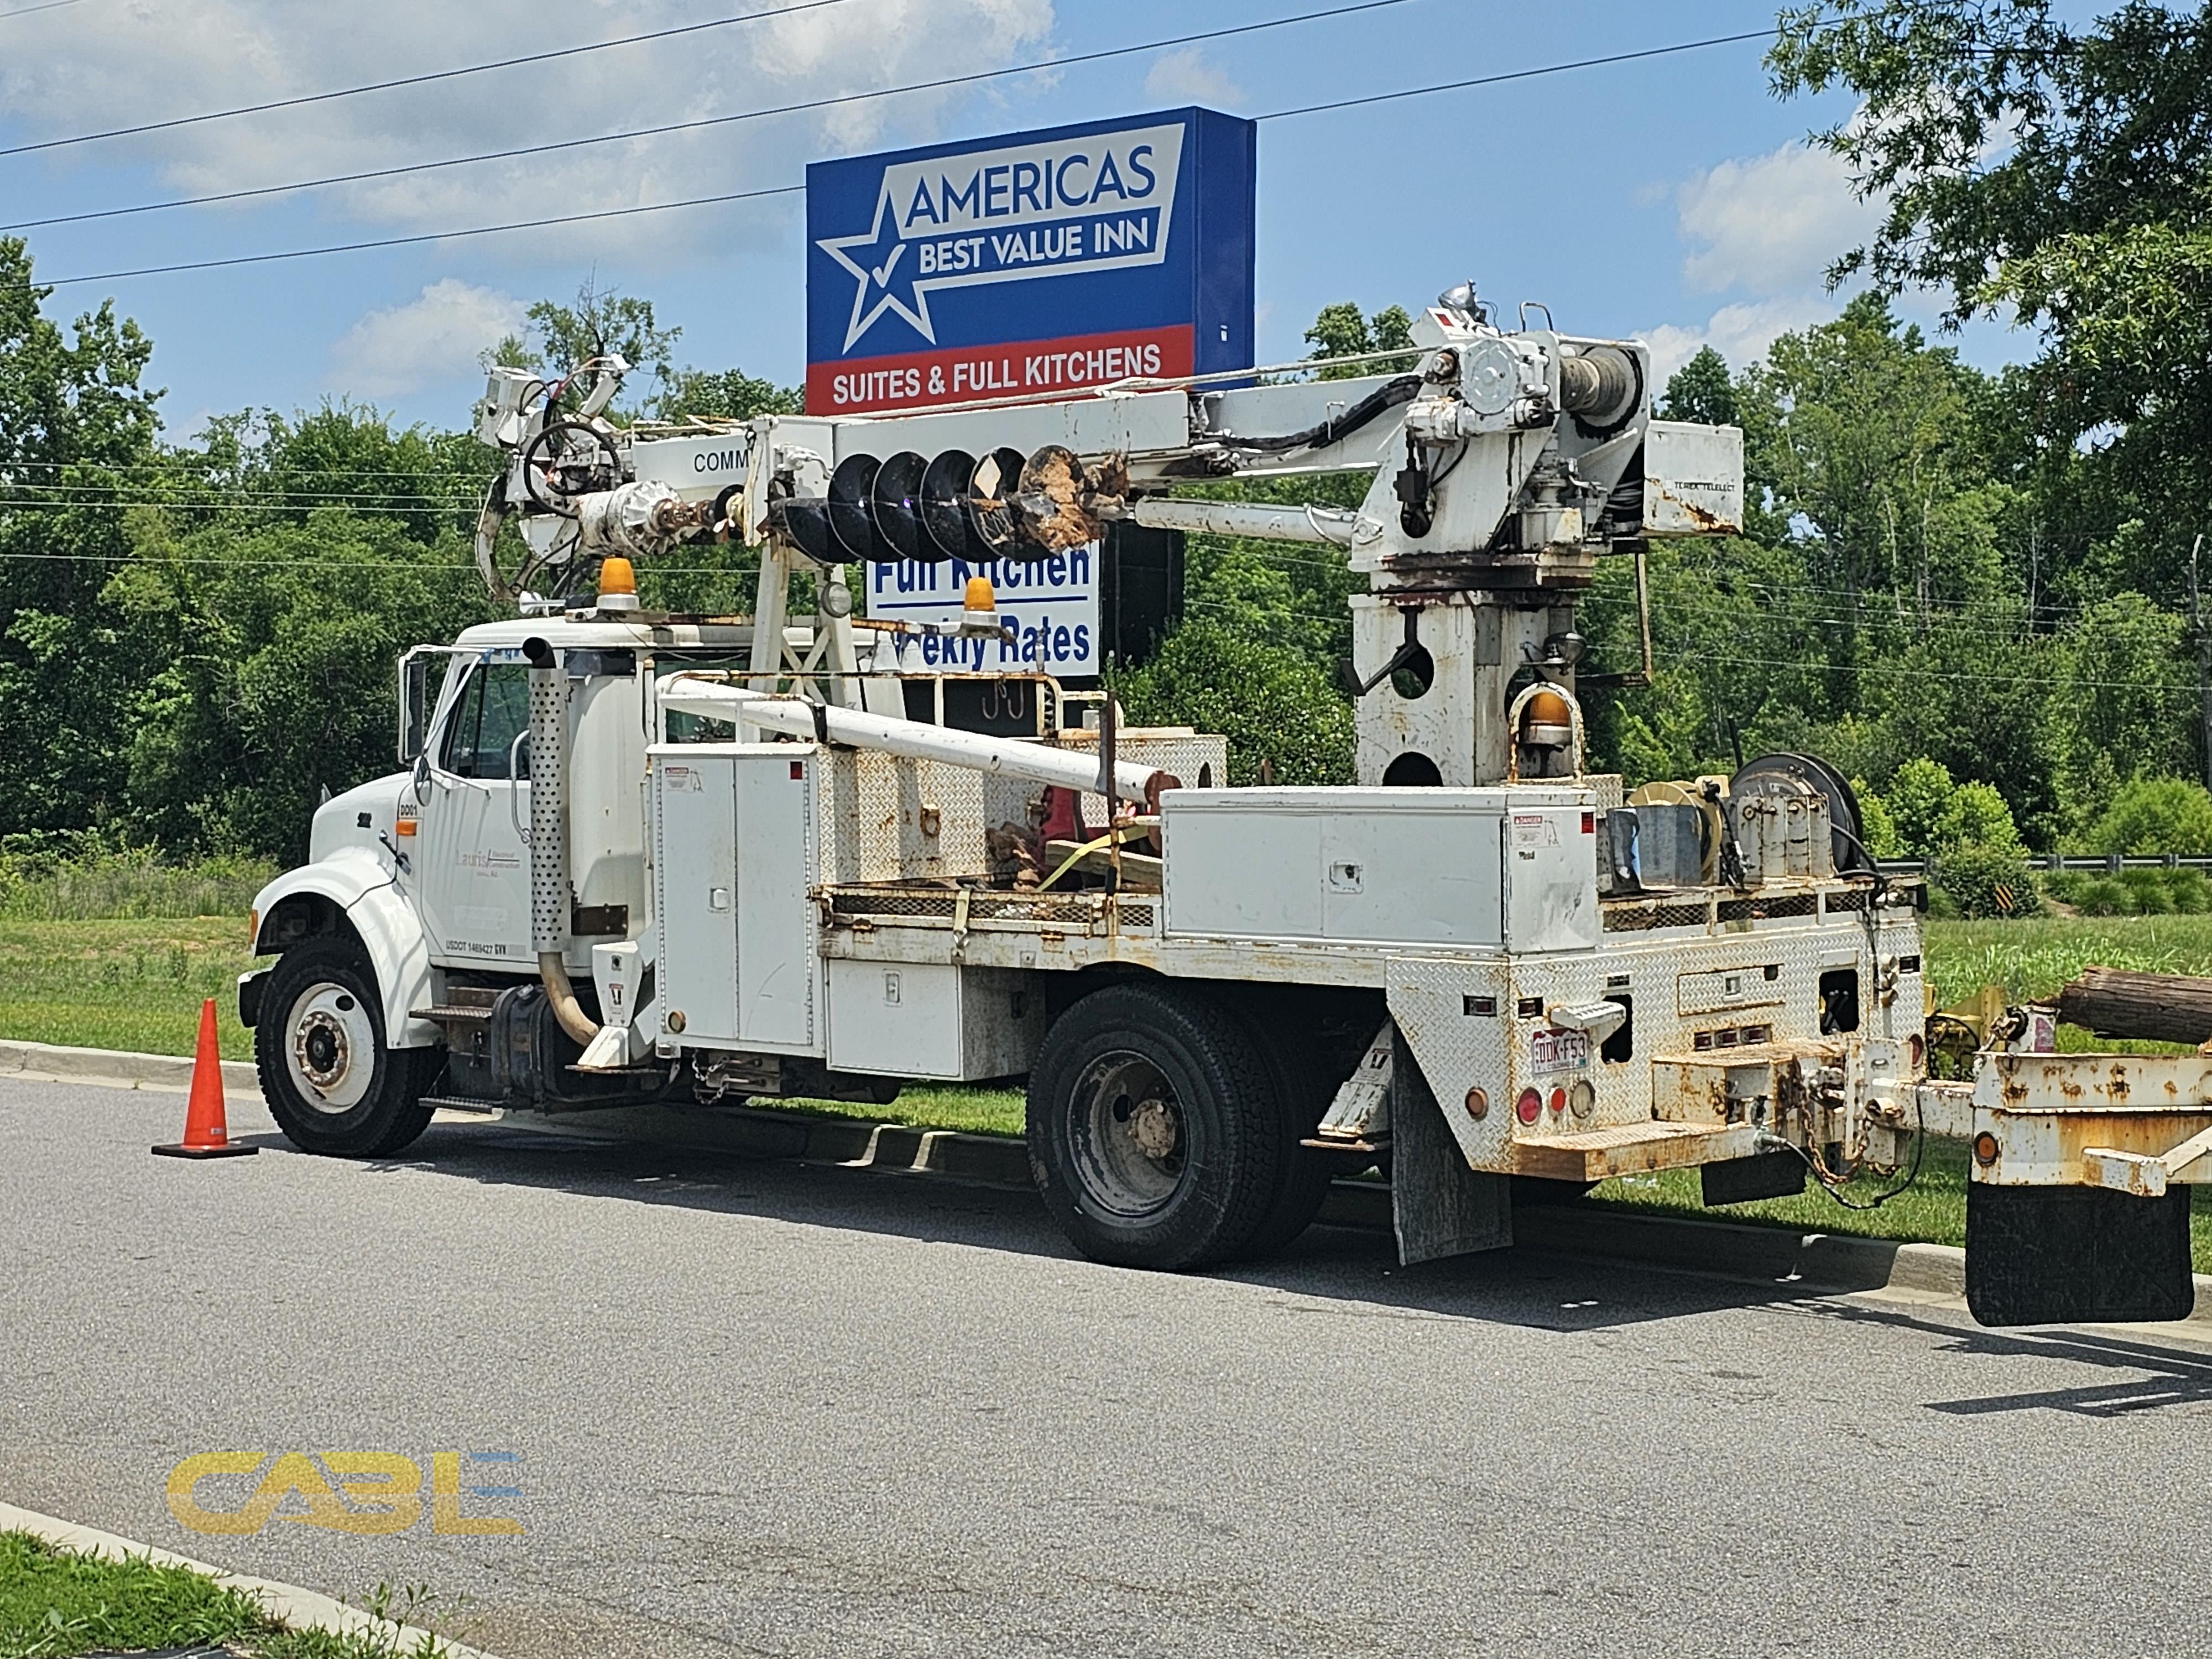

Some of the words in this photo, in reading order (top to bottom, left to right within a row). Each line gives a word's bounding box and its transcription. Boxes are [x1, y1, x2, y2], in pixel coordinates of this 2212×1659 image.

[906, 145, 1156, 228] AMERICAS
[920, 237, 985, 274] BEST
[992, 226, 1082, 264] VALUE
[1095, 217, 1149, 253] INN
[833, 367, 920, 404] SUITES
[928, 366, 946, 394] &
[953, 357, 1022, 392] FULL
[1025, 343, 1161, 385] KITCHENS
[875, 558, 936, 593] Full
[895, 617, 987, 671] ekly
[1000, 615, 1090, 662] Rates
[446, 940, 466, 951] USDOT
